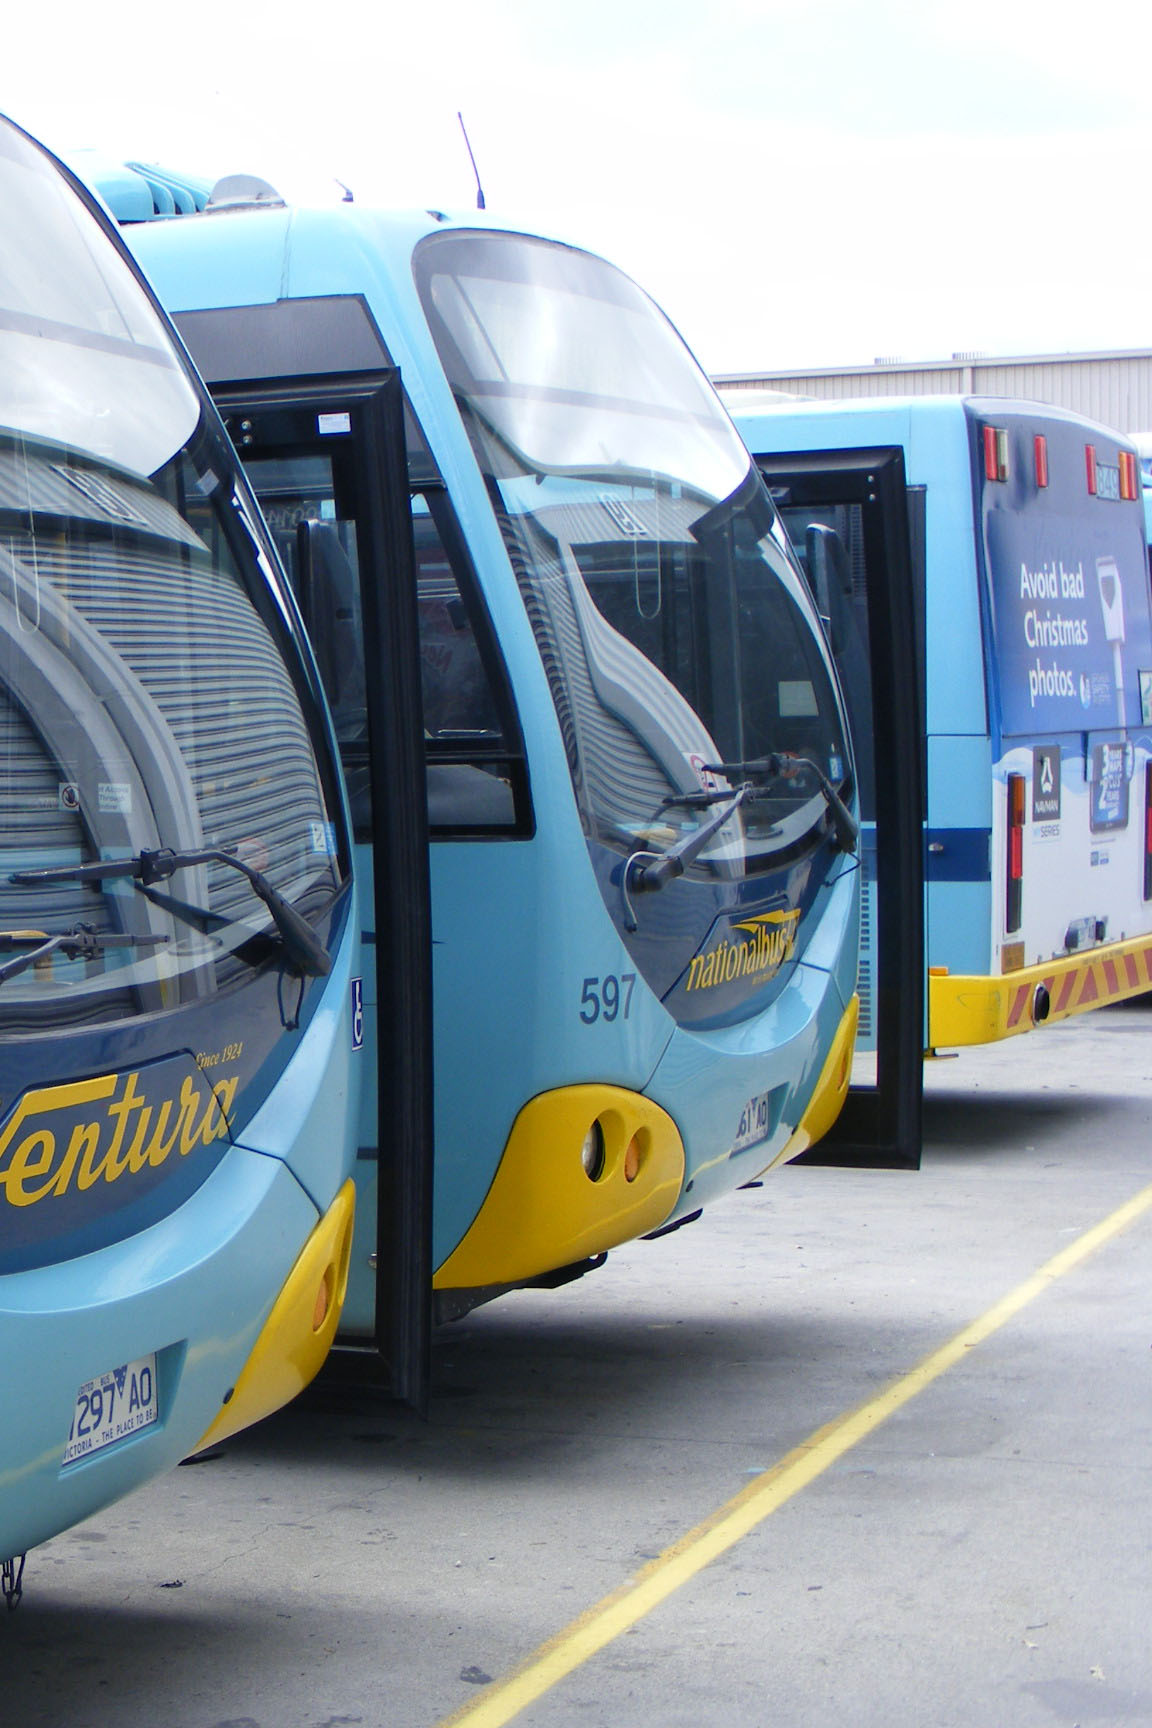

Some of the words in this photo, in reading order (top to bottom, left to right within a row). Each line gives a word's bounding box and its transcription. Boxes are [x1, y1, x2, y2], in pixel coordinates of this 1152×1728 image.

[1020, 562, 1057, 599] Avoid
[1060, 562, 1085, 599] bad
[1024, 610, 1088, 648] Christmas
[1029, 659, 1077, 708] photos.
[1034, 799, 1059, 815] NAVMAN
[1040, 824, 1060, 838] SERIES
[686, 924, 786, 992] nationalbus
[579, 973, 636, 1025] 597
[196, 1052, 220, 1071] Since
[222, 1041, 244, 1063] 1924
[129, 1367, 152, 1414] AO
[102, 1428, 114, 1443] THE
[117, 1418, 134, 1435] PLACE
[136, 1414, 144, 1425] TO
[146, 1409, 153, 1421] BE
